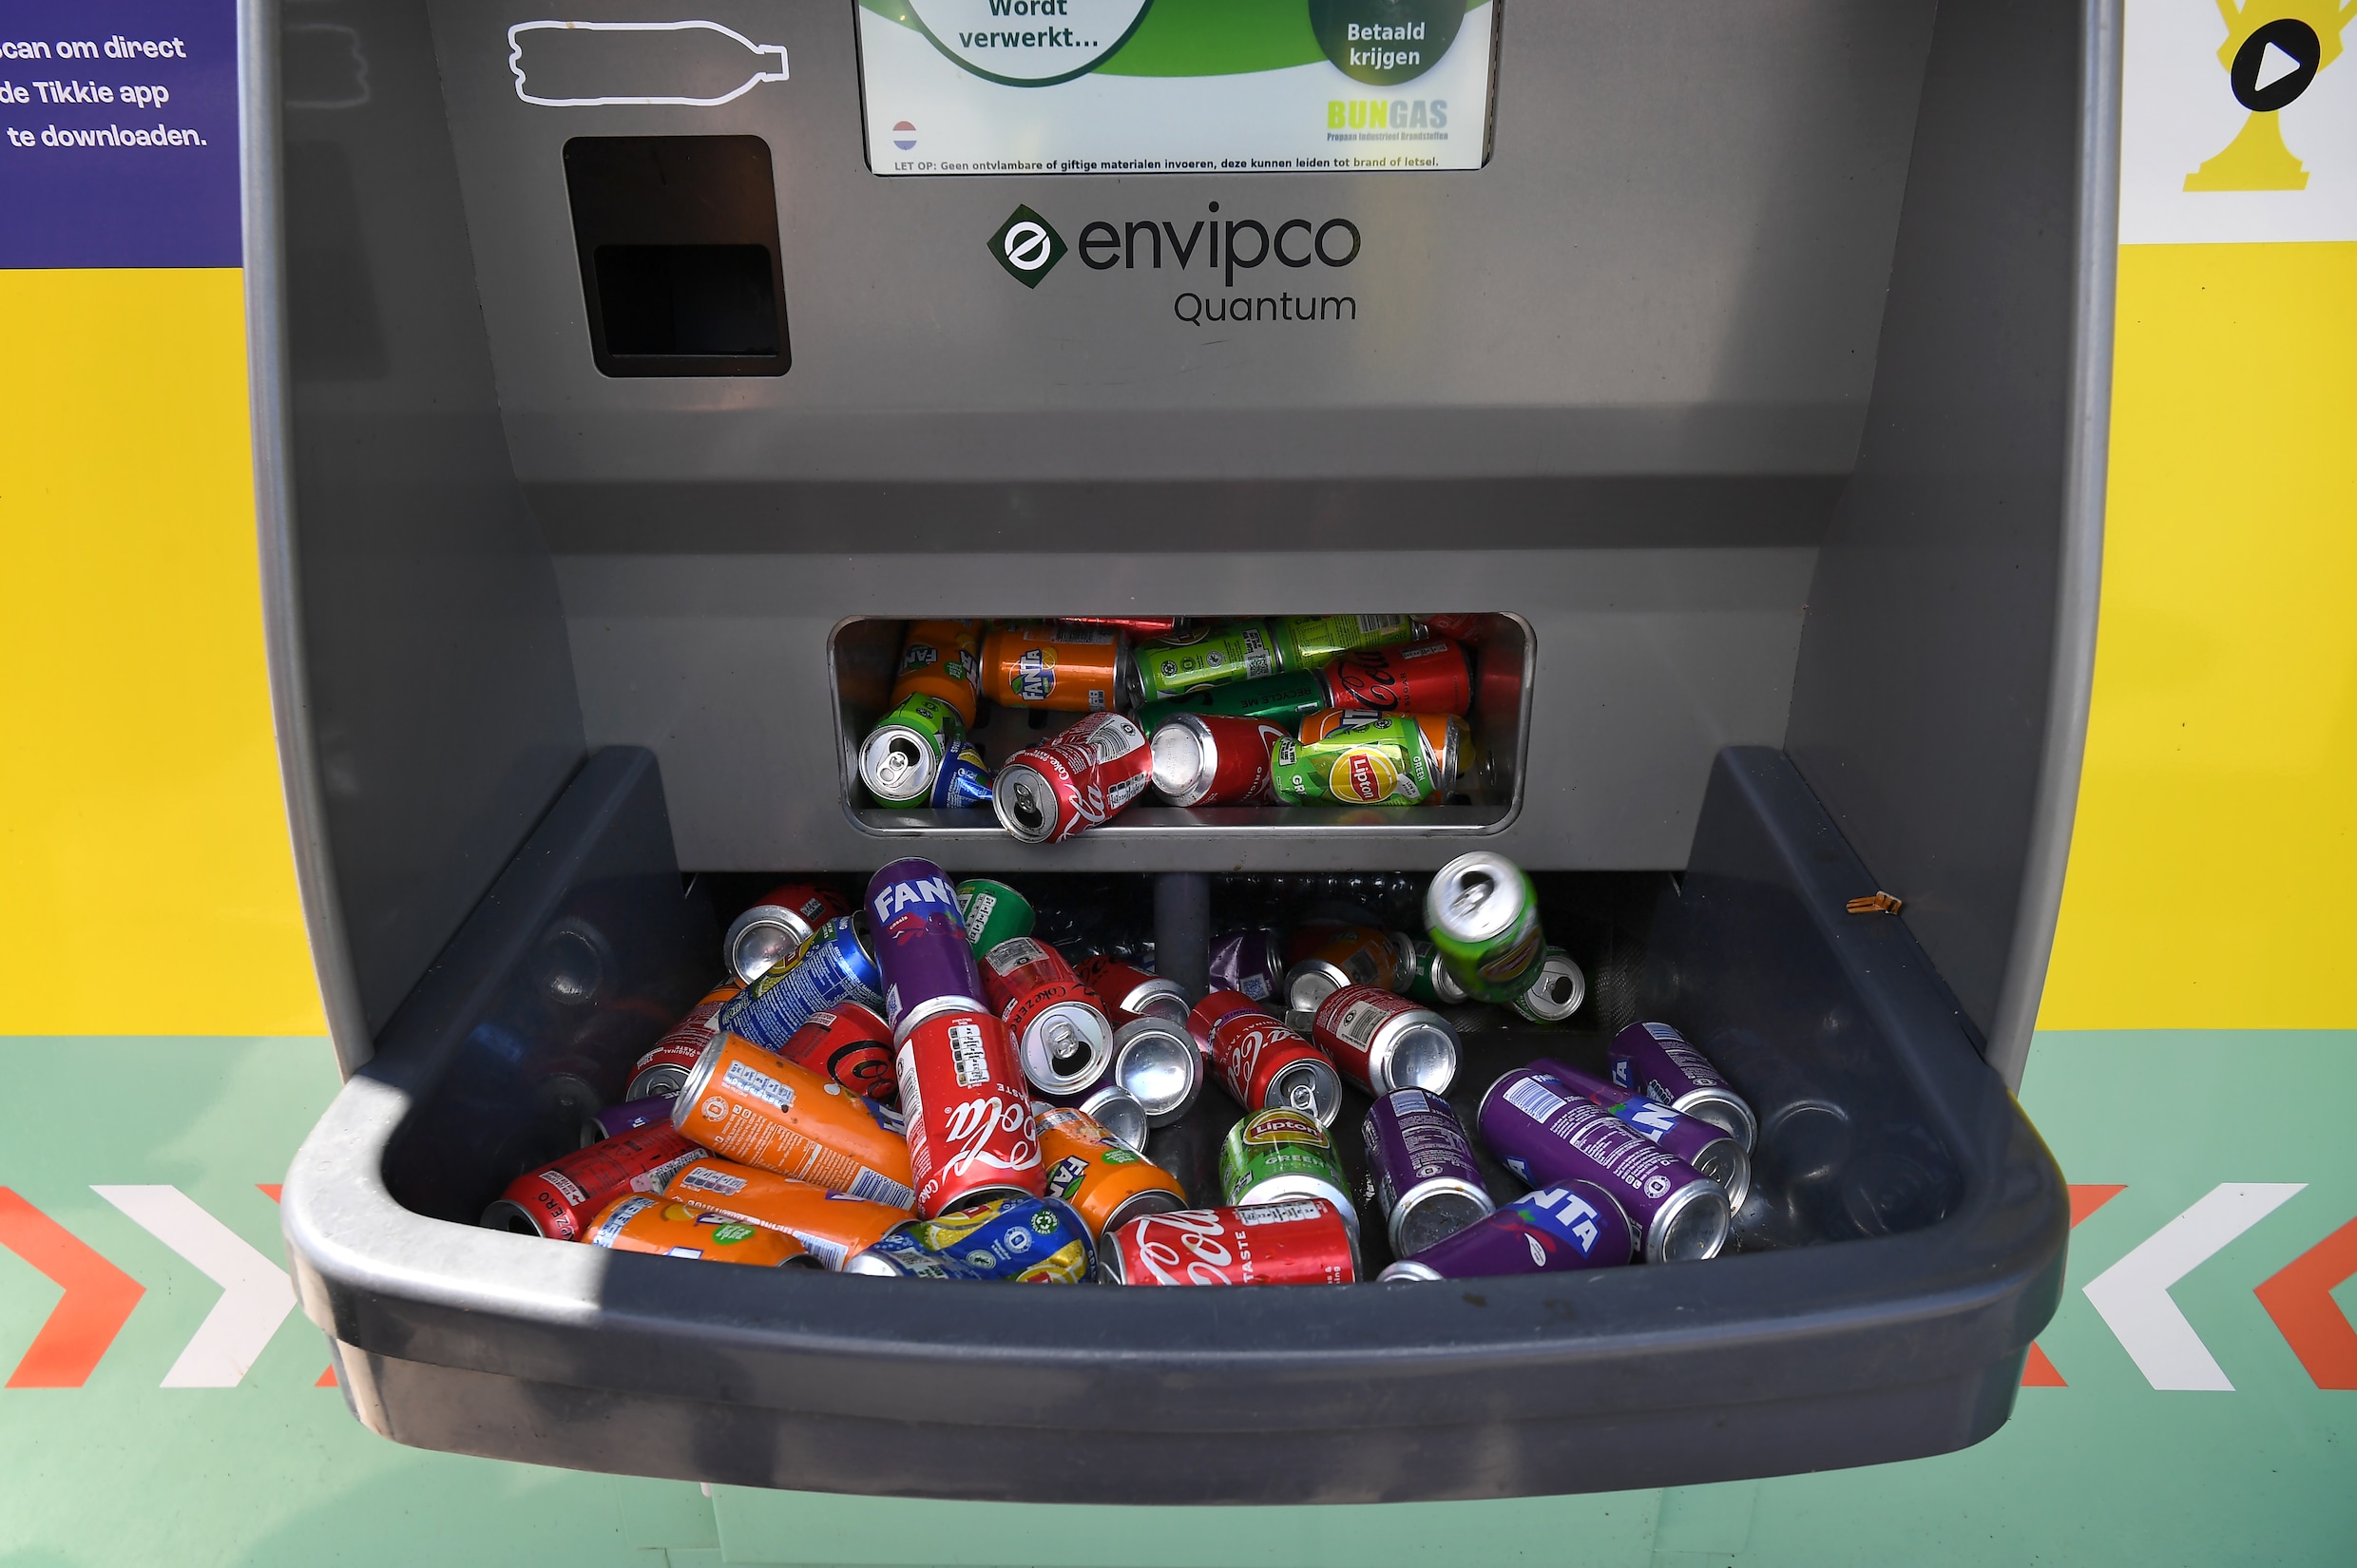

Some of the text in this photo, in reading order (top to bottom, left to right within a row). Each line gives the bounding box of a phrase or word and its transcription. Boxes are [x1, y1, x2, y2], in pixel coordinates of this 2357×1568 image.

[959, 27, 1098, 48] verwerkt...
[1348, 22, 1425, 41] Betaald
[0, 35, 186, 59] can om direct
[1350, 48, 1420, 69] krijgen
[0, 81, 169, 108] de Tikkie app
[1328, 100, 1447, 129] BUNGAS
[7, 124, 207, 146] te downloaden.
[895, 157, 1439, 171] LET OP: Geen ontvlambare of giftige materialen invoeren, deze kunnen leiden tot brand of letsel.
[1079, 201, 1361, 286] envipco
[1174, 292, 1356, 326] Quantum
[1021, 649, 1044, 700] FANTA
[1241, 686, 1312, 708] RECYCLE ME
[1401, 673, 1410, 704] SUGAR
[1050, 756, 1070, 780] Coke
[1353, 758, 1374, 799] Lipton
[1413, 755, 1425, 781] GREEN
[874, 876, 960, 923] FANT
[1035, 985, 1066, 1004] Coke
[997, 1083, 1029, 1107] ASTE
[1255, 1119, 1319, 1138] Lipton
[1265, 1154, 1325, 1169] GREEN
[922, 1179, 939, 1203] Coke
[539, 1192, 570, 1229] ZERO
[1236, 1231, 1254, 1283] TASTE
